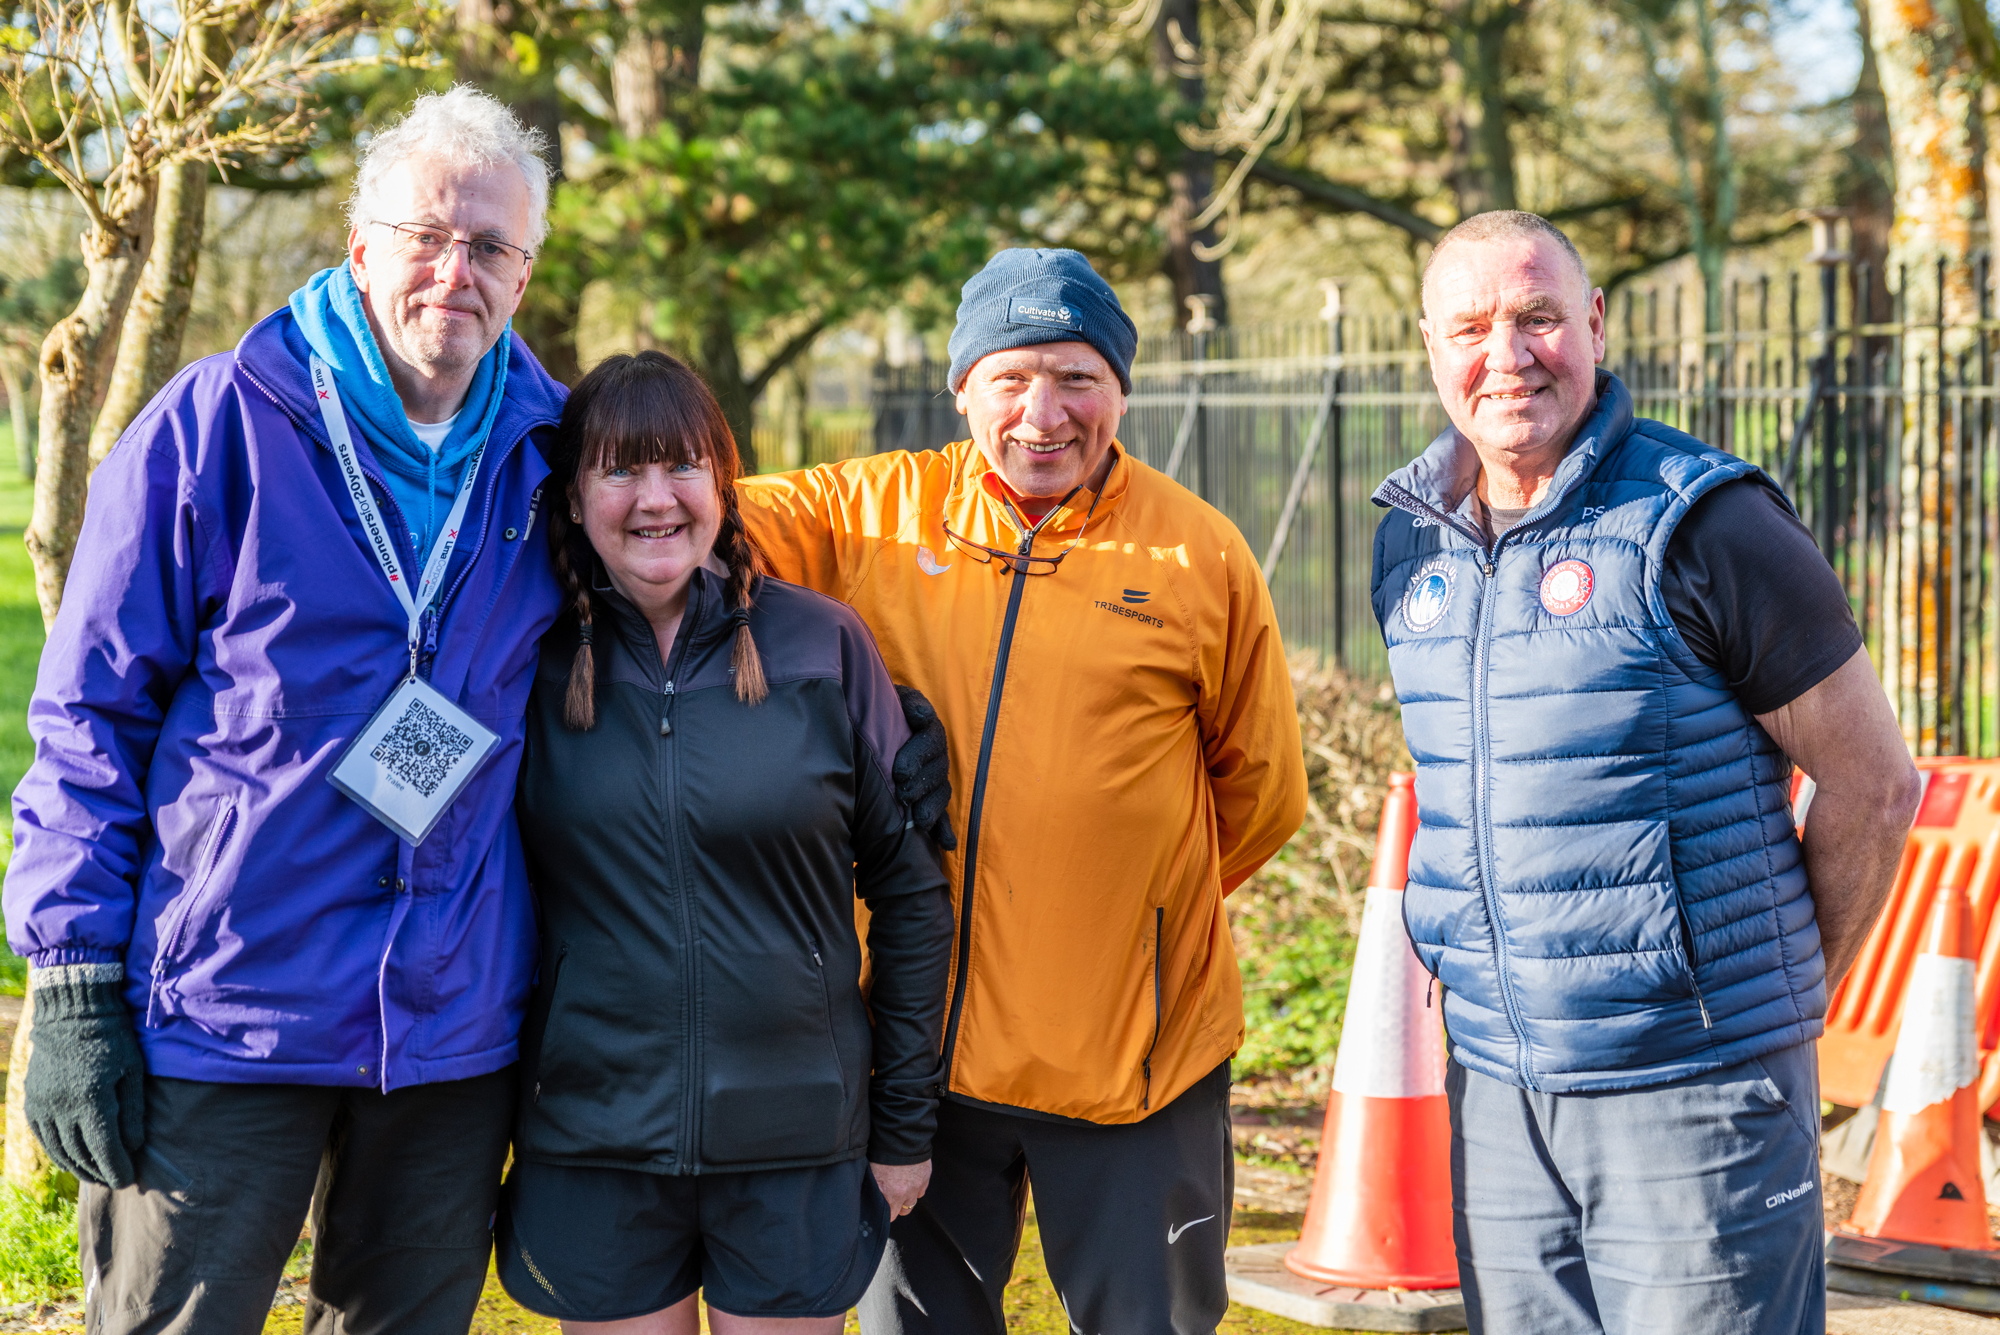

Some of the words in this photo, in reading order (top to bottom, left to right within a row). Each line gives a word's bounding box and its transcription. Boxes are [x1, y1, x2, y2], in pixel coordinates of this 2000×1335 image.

[1018, 305, 1056, 317] Cultivate
[338, 443, 400, 582] #pioneersfor20years
[1581, 505, 1605, 520] PS
[1549, 564, 1566, 578] NEW
[1569, 564, 1587, 577] YORK
[1553, 601, 1571, 610] GAA
[1094, 600, 1164, 629] TRIBESPORTS
[385, 773, 405, 792] Tralee
